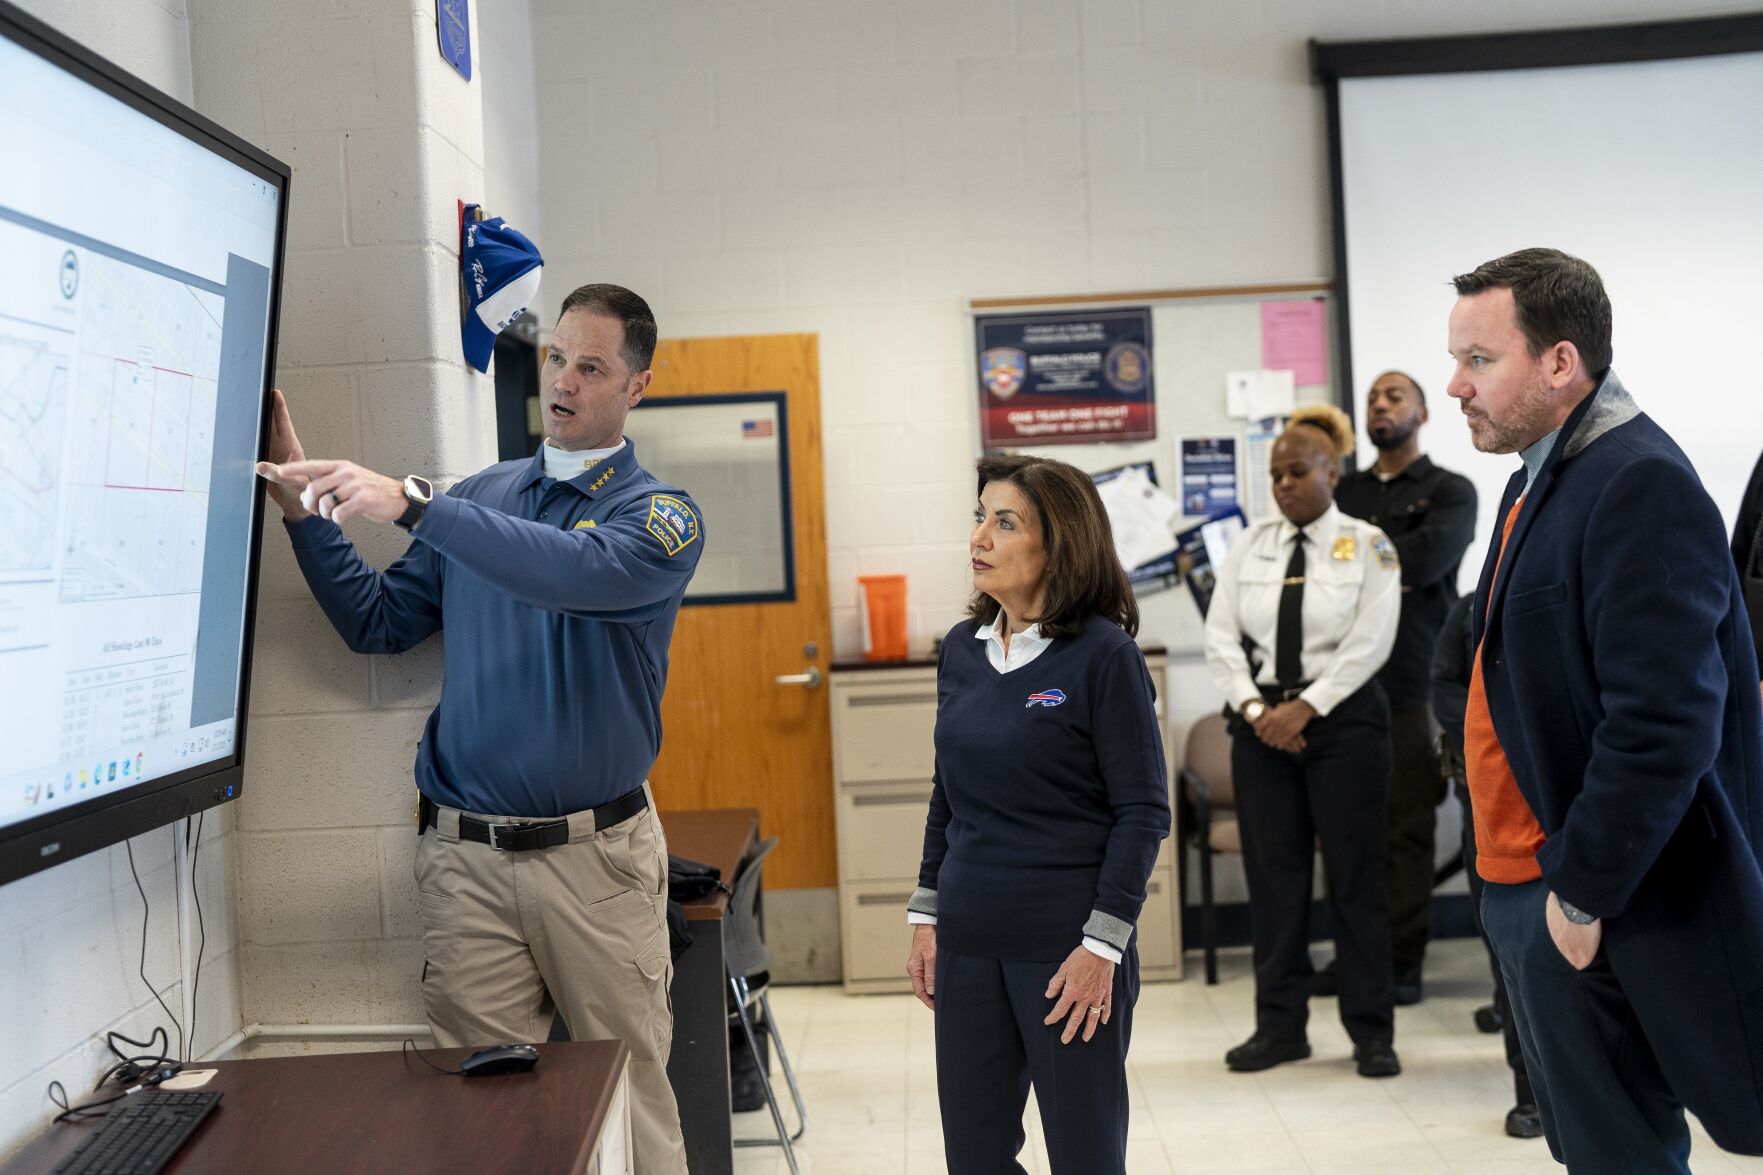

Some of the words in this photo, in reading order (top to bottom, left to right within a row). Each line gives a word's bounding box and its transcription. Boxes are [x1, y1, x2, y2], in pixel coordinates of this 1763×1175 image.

[1008, 411, 1033, 424] ONE
[1036, 409, 1066, 421] TEAM
[1068, 407, 1092, 420] ONE
[584, 458, 604, 469] BP
[652, 523, 675, 549] POLICE
